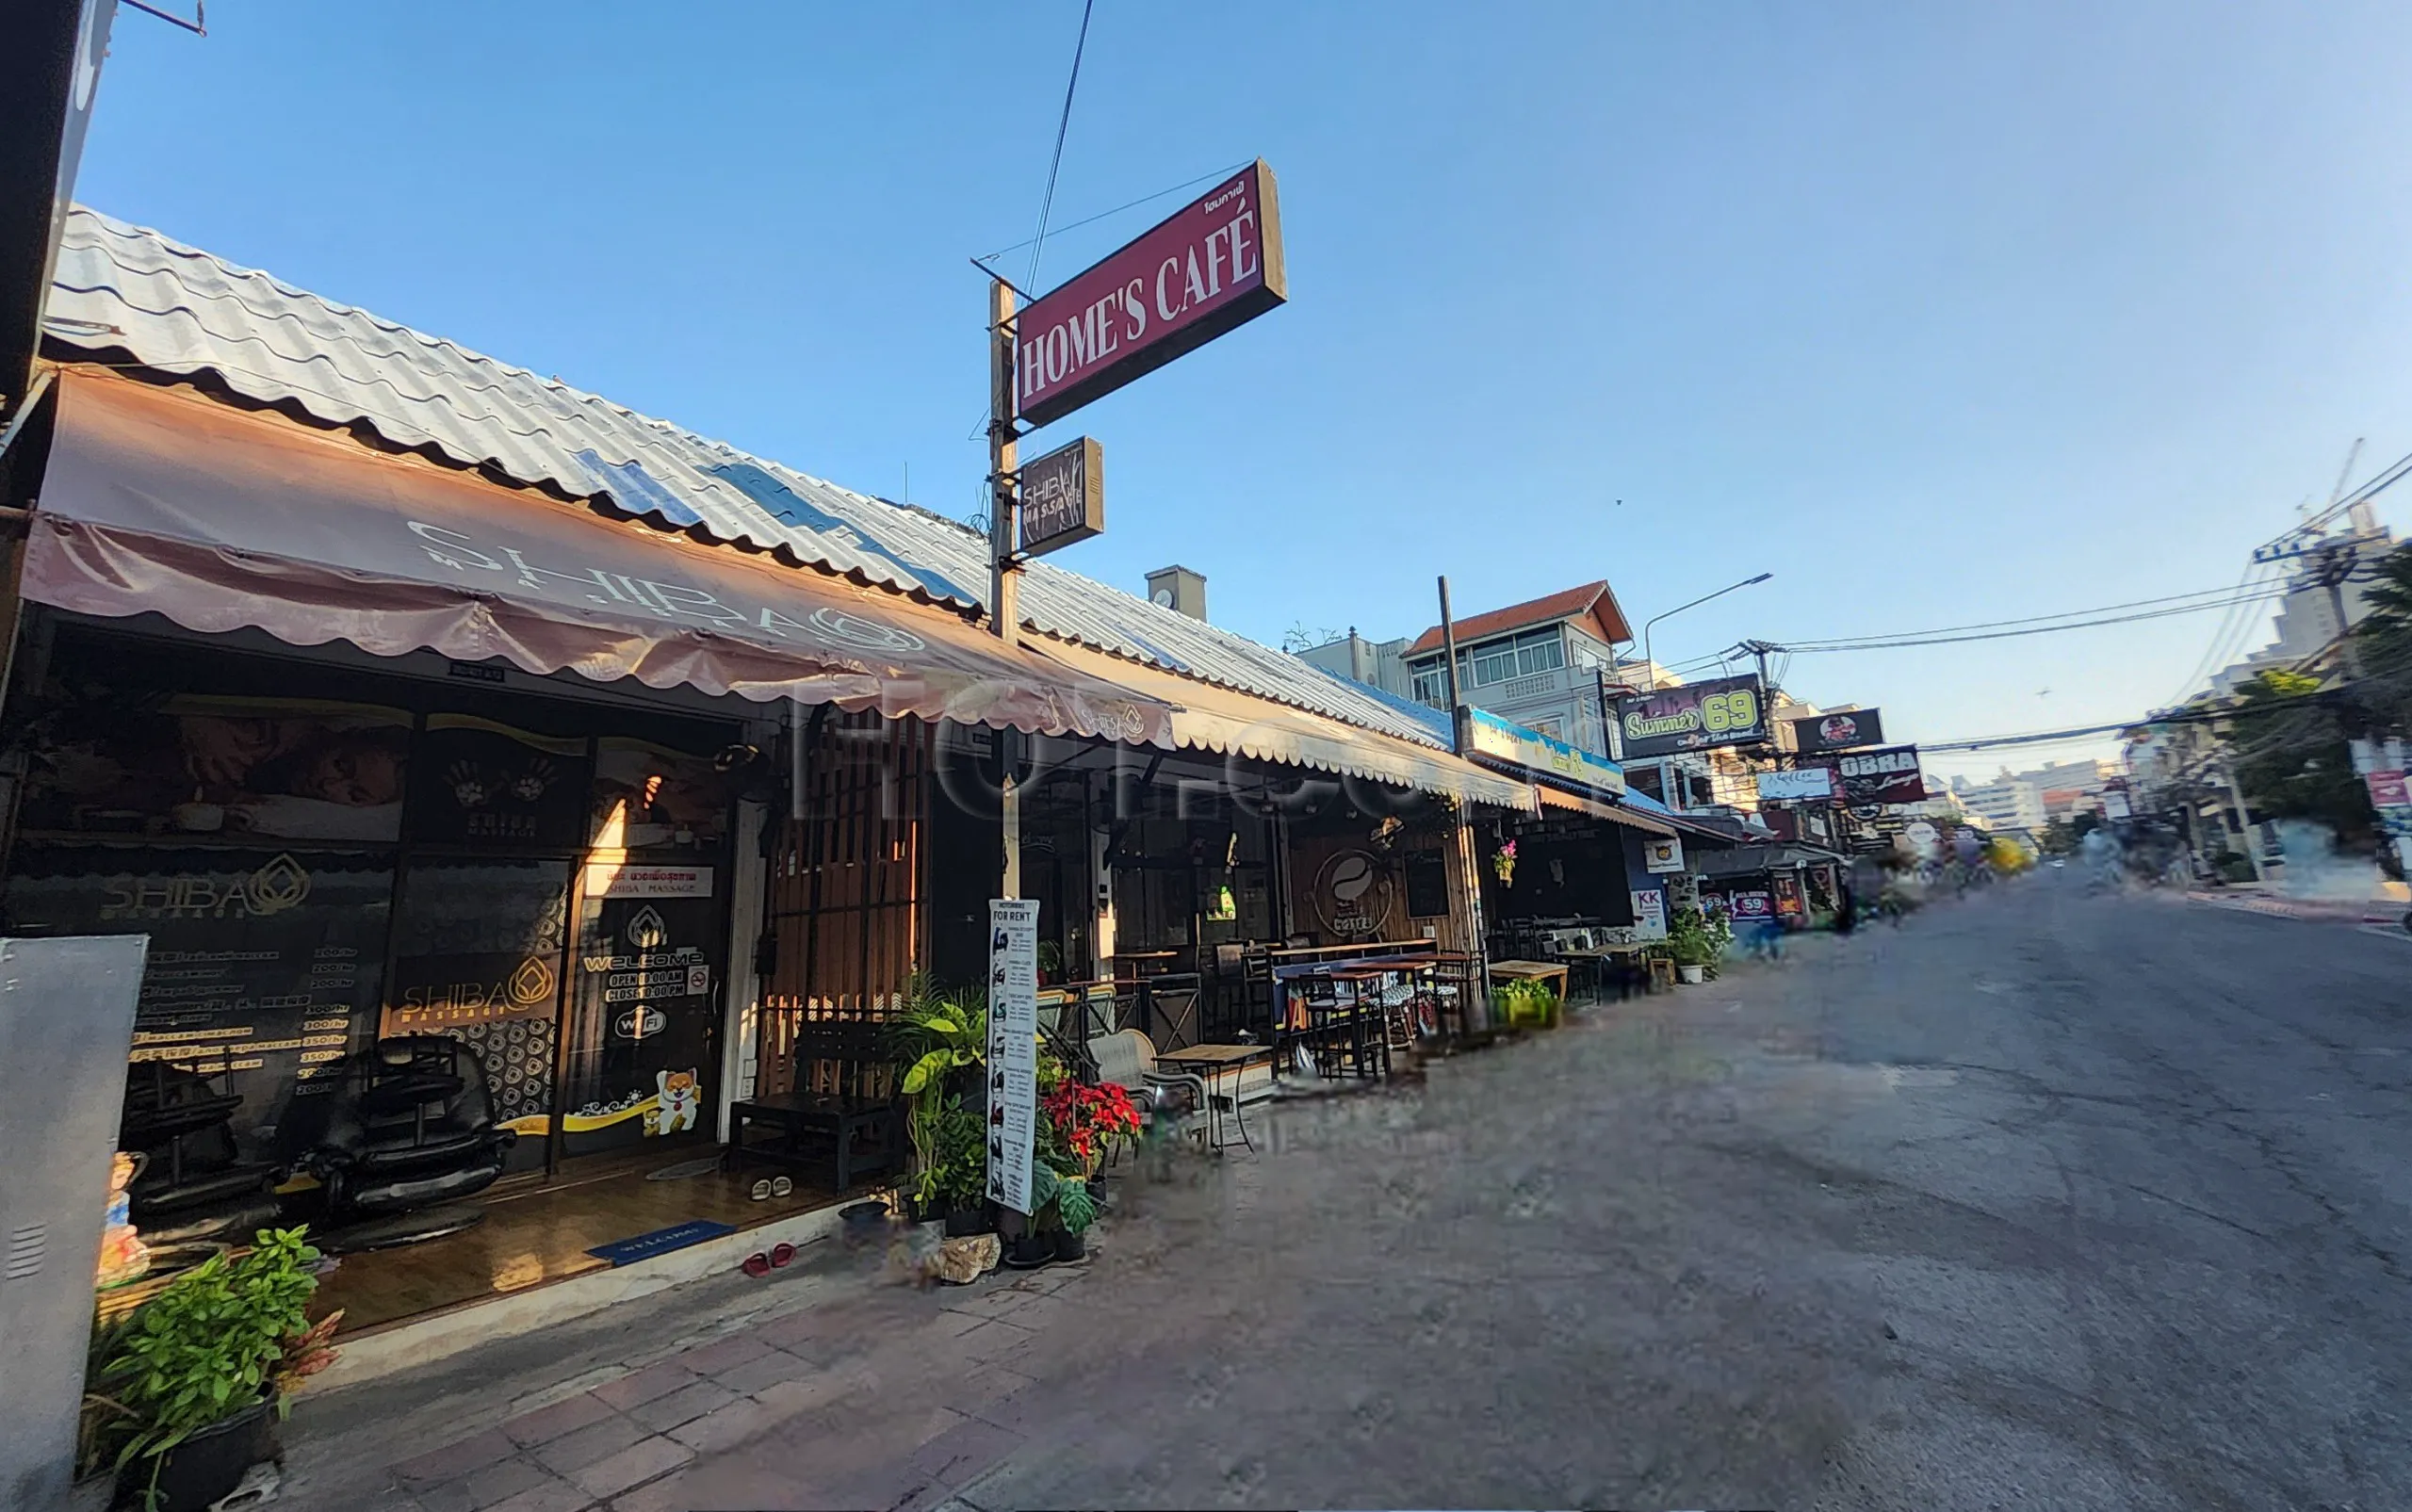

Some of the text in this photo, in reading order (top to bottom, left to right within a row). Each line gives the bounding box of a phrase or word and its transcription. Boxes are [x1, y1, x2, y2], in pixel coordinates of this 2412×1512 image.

[1022, 197, 1257, 399] HOME'S CAFÉ
[1023, 472, 1072, 508] SHIBA
[406, 519, 803, 638] SHIBA
[1624, 689, 1759, 740] Summer 69
[100, 877, 249, 910] SHIBA
[993, 910, 1031, 922] FOR RENT
[608, 989, 638, 1000] CLOSE
[669, 985, 684, 995] PM
[611, 975, 637, 986] OPEN
[668, 971, 682, 982] AM
[401, 981, 510, 1015] SHIBA
